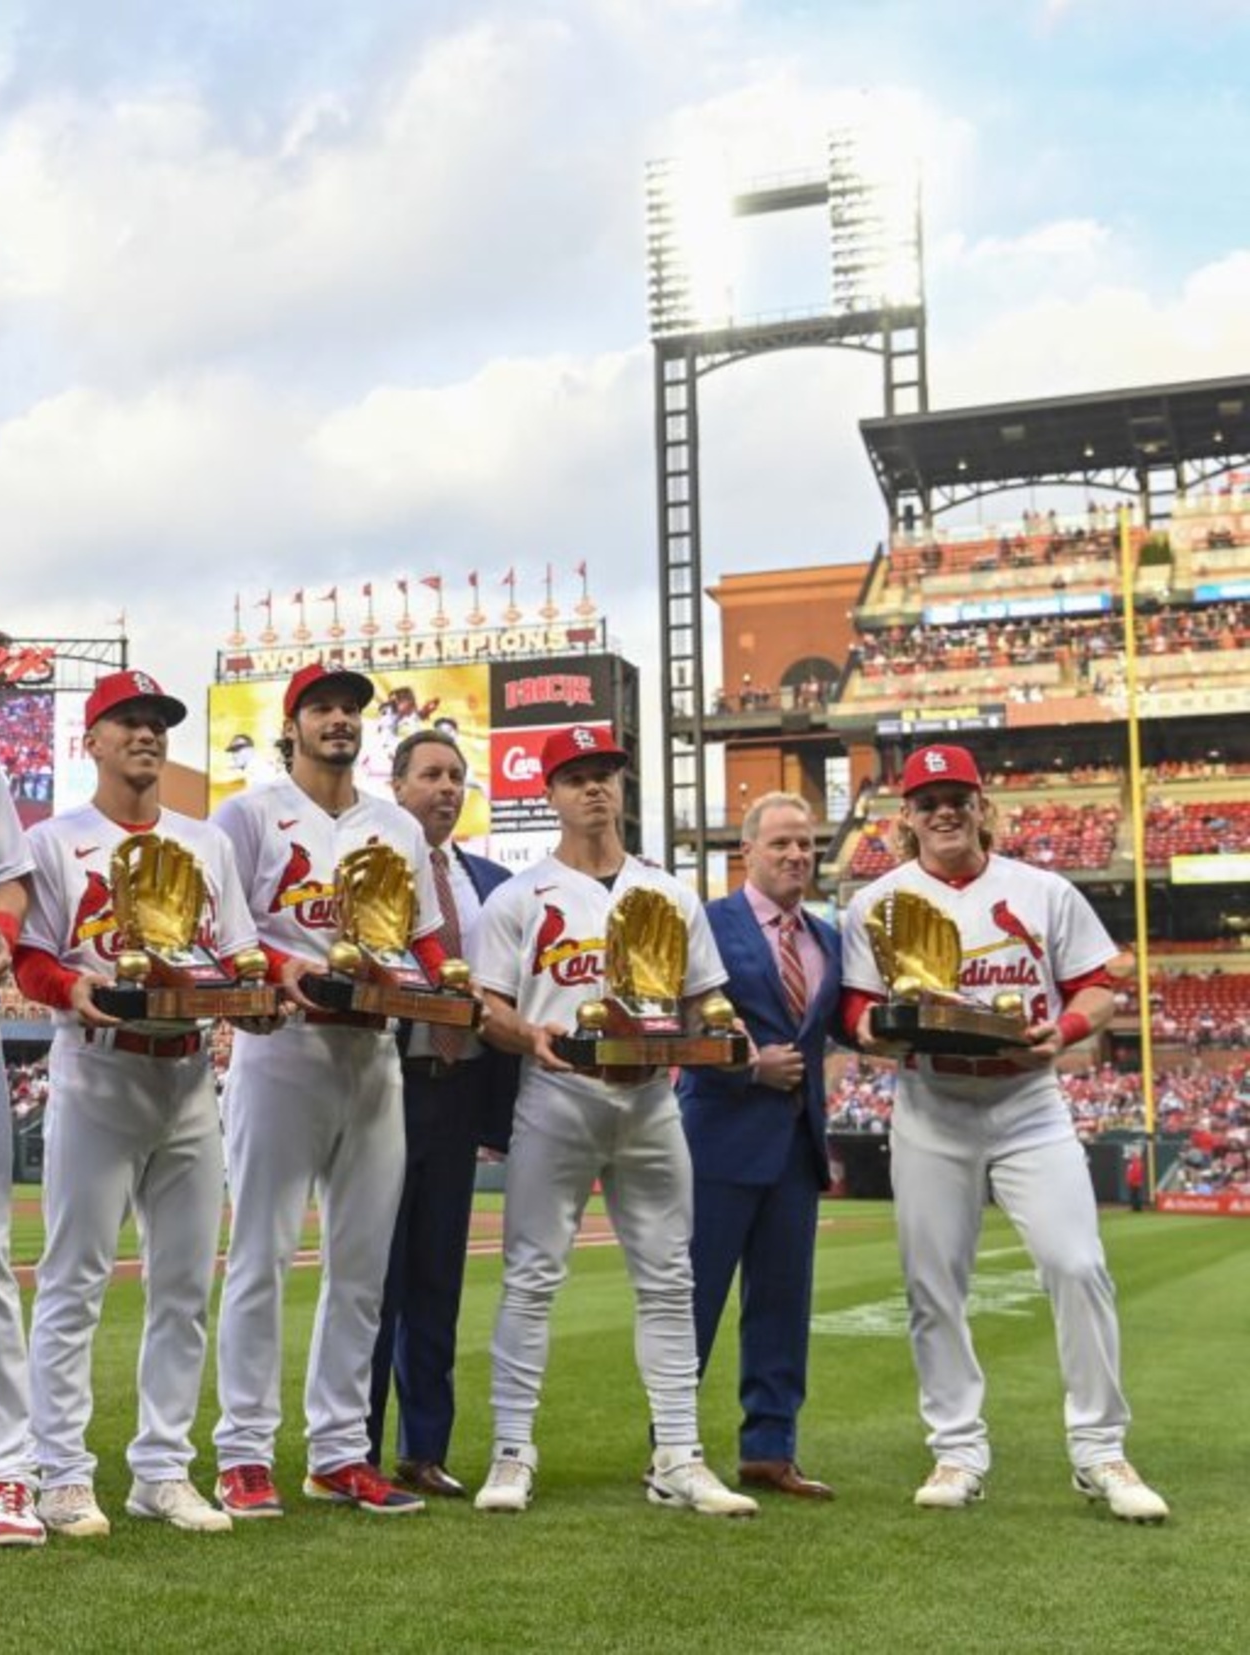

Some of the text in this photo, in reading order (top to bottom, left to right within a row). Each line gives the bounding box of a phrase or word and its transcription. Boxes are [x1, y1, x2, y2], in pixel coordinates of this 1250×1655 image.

[253, 645, 363, 673] WORLD
[373, 628, 567, 662] CHAMPIONS
[960, 956, 1042, 987] dinals
